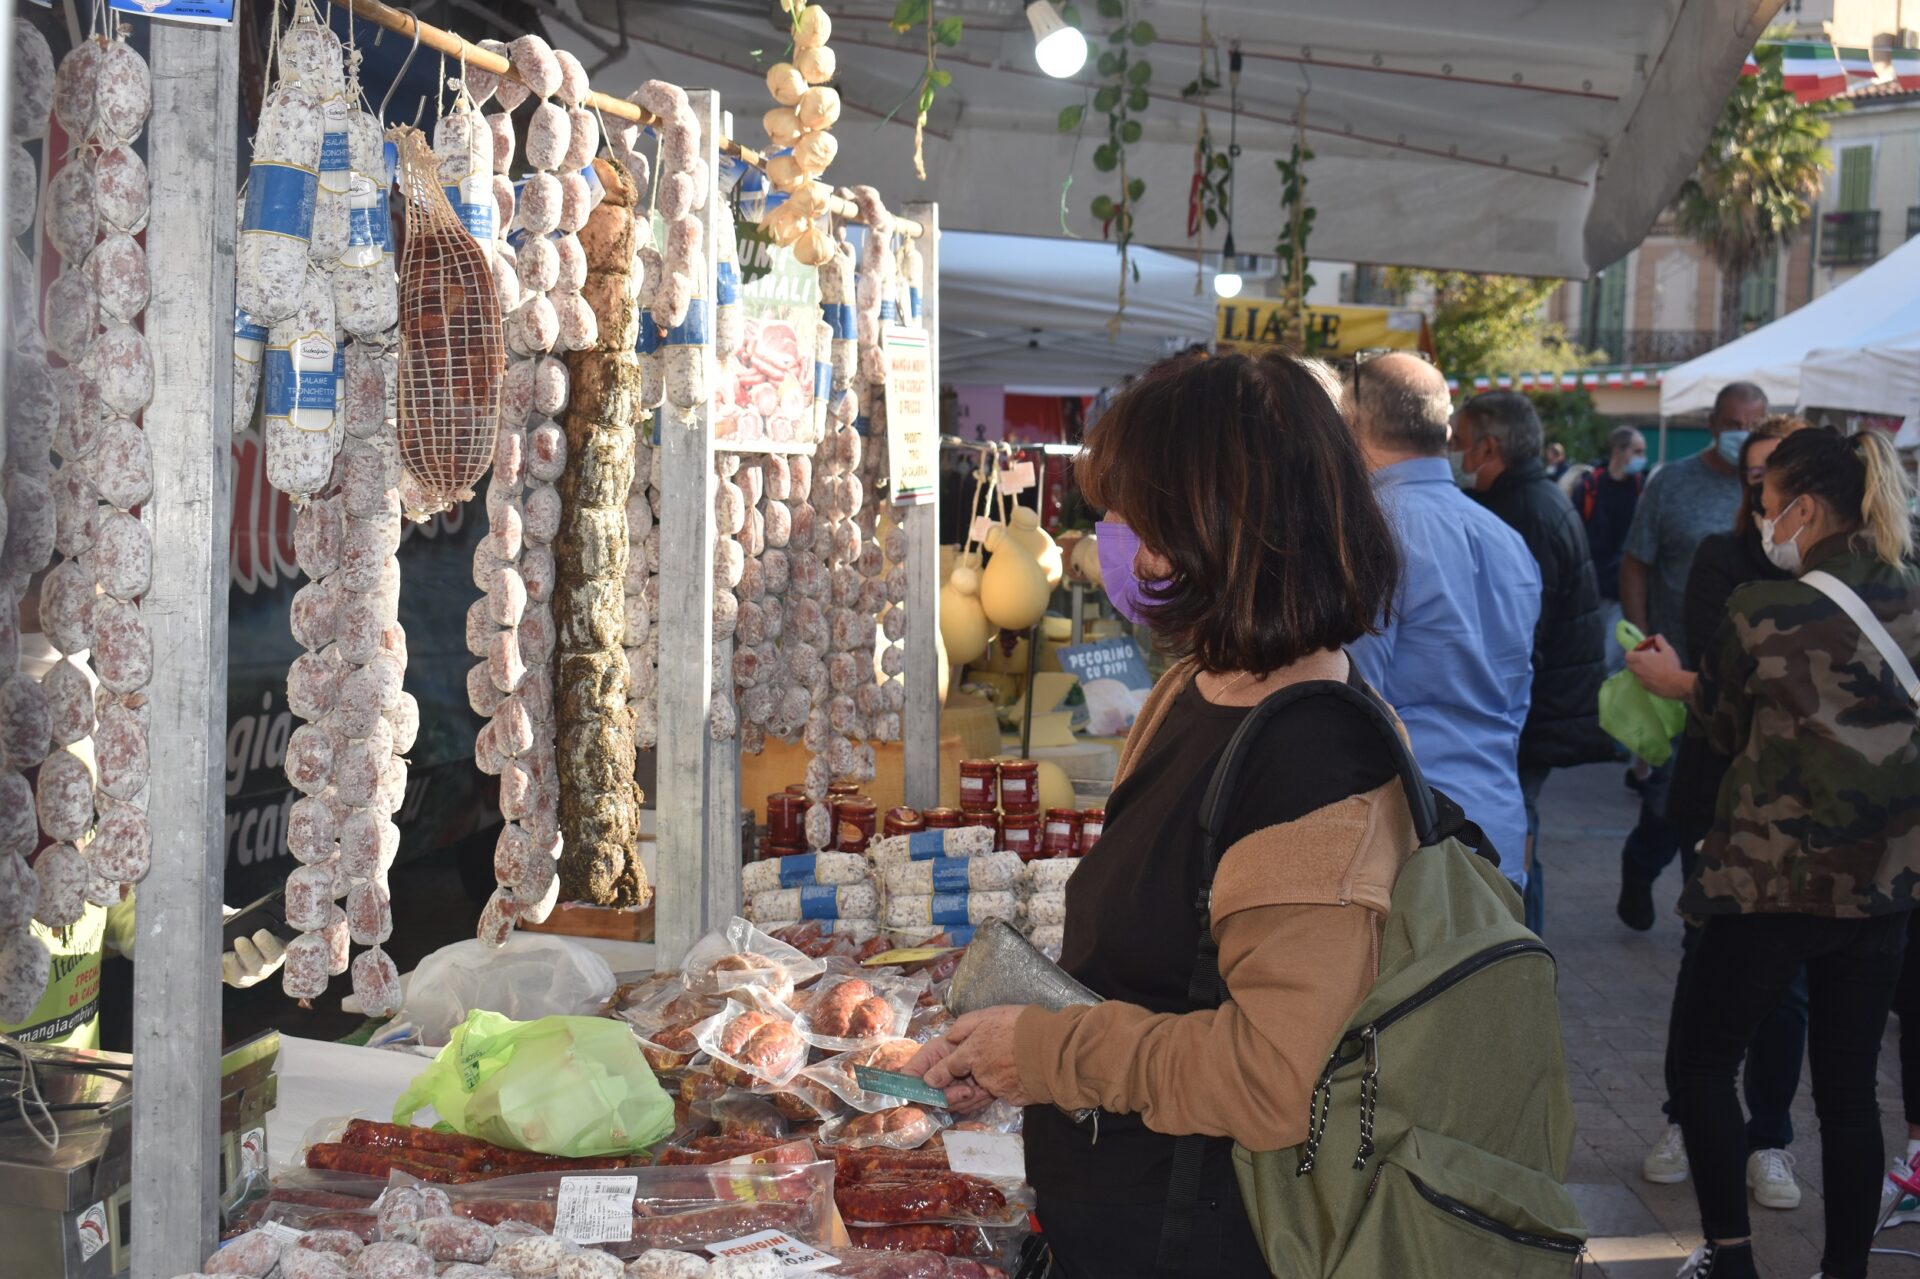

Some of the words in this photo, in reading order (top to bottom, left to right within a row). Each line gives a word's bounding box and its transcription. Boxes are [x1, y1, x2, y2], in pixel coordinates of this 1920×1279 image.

[299, 376, 328, 385] SALAME
[288, 387, 335, 396] TRONCHETTO
[1068, 645, 1134, 669] PECORINO
[1103, 661, 1128, 676] PIPI
[720, 1235, 788, 1258] PERUGINI
